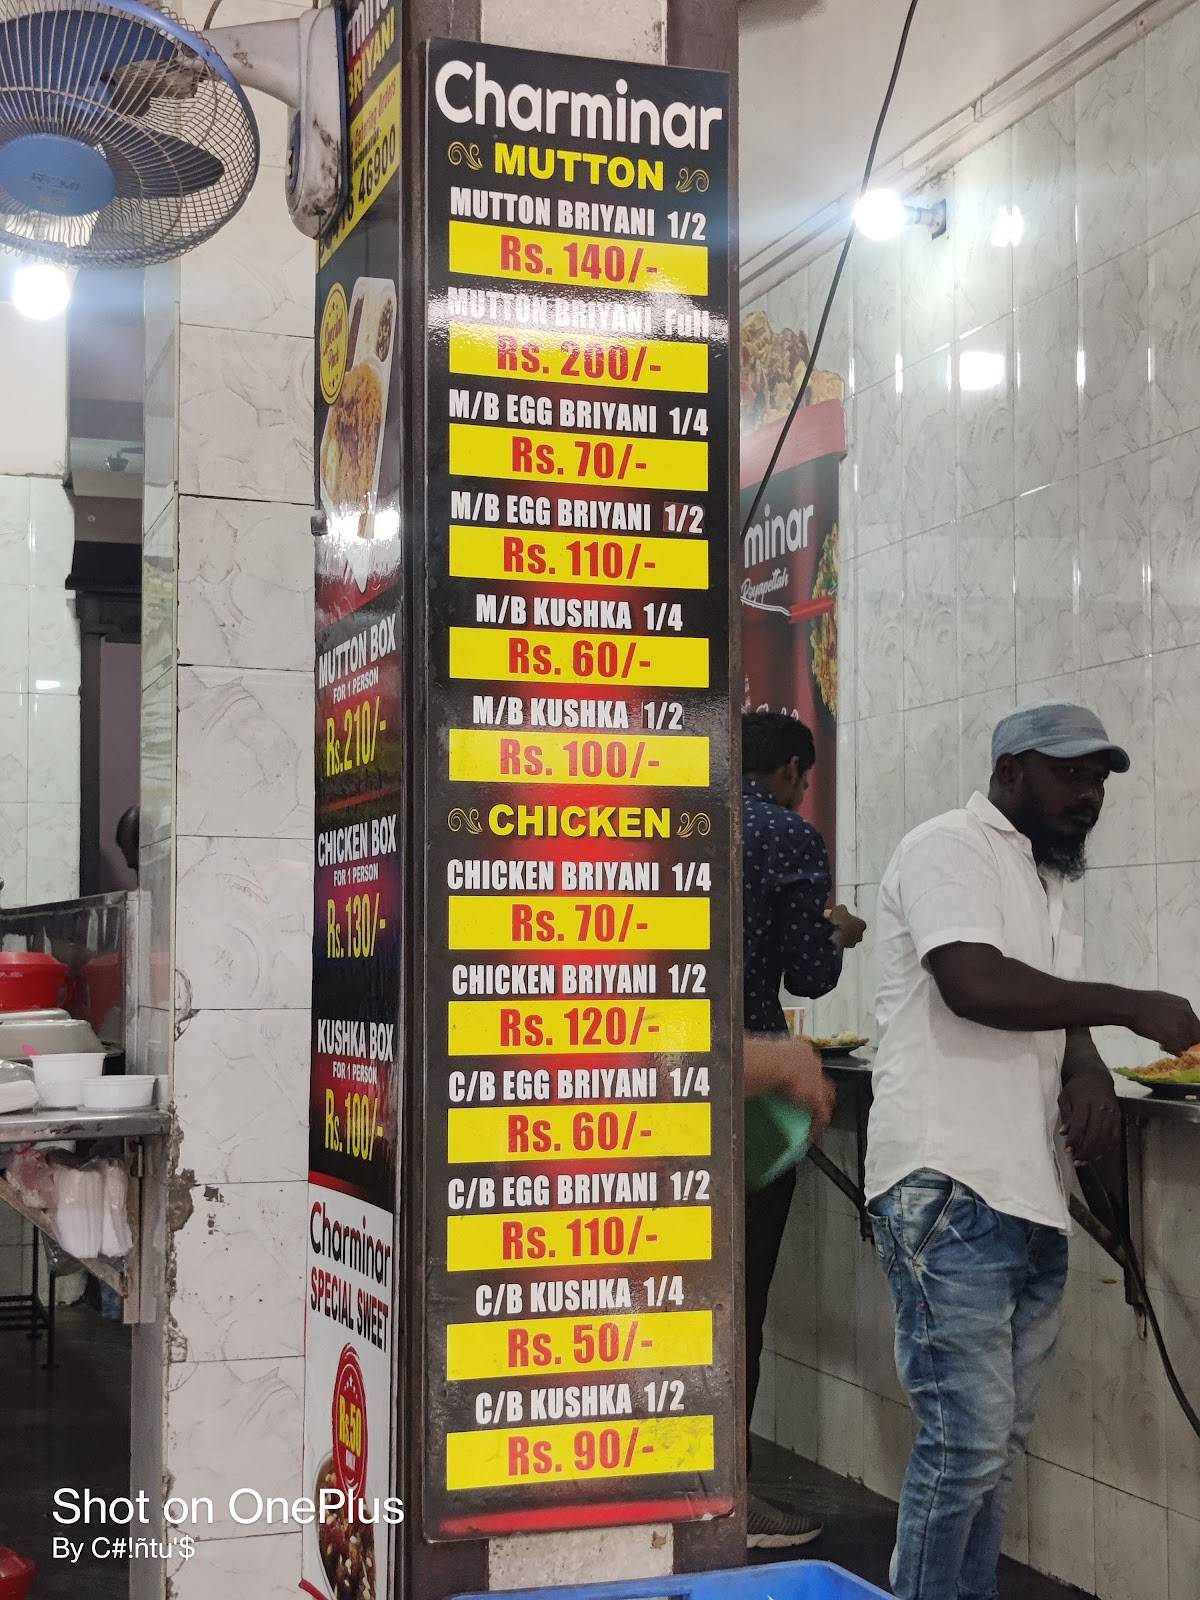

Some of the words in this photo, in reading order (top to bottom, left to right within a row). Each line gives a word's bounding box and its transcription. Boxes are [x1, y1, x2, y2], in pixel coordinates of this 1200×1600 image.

[434, 60, 723, 150] Charminar
[359, 123, 396, 205] 46900
[494, 142, 664, 191] MUTTON
[450, 186, 551, 226] MUTTON
[558, 200, 655, 237] BRIYANI
[667, 212, 706, 240] 1/2
[500, 235, 553, 275] Rs.
[563, 242, 657, 283] 140/-
[448, 286, 548, 326] MUTTON
[555, 297, 649, 334] BRIYANI
[665, 308, 709, 337] Full
[498, 333, 549, 374] Rs.
[561, 340, 662, 382] 200/-
[449, 389, 499, 421] M/B
[507, 394, 552, 426] EGG
[560, 399, 656, 433] BRIYANI
[669, 407, 708, 436] 1/4
[512, 436, 564, 475] Rs.
[574, 441, 647, 480] 70/-
[450, 491, 500, 521] M/B
[507, 496, 550, 526] EGG
[557, 499, 650, 531] BRIYANI
[664, 504, 704, 533] 1/2
[503, 536, 555, 575] Rs.
[566, 540, 656, 580] 110/-
[476, 594, 526, 625] M/B
[534, 597, 632, 629] KUSHKA
[643, 603, 683, 631] 1/4
[318, 630, 367, 689] MUTTON
[370, 613, 396, 663] BOX
[508, 637, 561, 675] Rs.
[572, 640, 651, 678] 60/-
[333, 685, 346, 705] FOR
[352, 667, 379, 696] PERSON
[473, 695, 523, 725] M/B
[530, 698, 628, 728] KUSHKA
[644, 701, 683, 730] 1/2
[500, 738, 552, 776] Rs.
[563, 740, 660, 779] 100/-
[317, 821, 368, 867] CHICKEN
[371, 814, 397, 857] BOX
[488, 803, 671, 838] CHICKEN
[333, 868, 346, 887] FOR
[352, 863, 379, 884] PERSON
[447, 859, 553, 891] CHICKEN
[561, 861, 660, 891] BRIYANI
[671, 862, 711, 891] 1/4
[511, 903, 565, 942] Rs.
[575, 903, 648, 943] 70/-
[452, 964, 555, 995] CHICKEN
[562, 964, 656, 994] BRIYANI
[668, 963, 706, 994] 1/2
[317, 1018, 366, 1058] KUSHKA
[369, 1022, 394, 1062] BOX
[500, 1008, 552, 1047] Rs.
[563, 1006, 660, 1046] 120/-
[332, 1060, 346, 1080] FOR
[352, 1063, 377, 1085] PERSON
[449, 1070, 495, 1102] C/B
[503, 1069, 550, 1101] EGG
[557, 1067, 657, 1100] BRIYANI
[670, 1067, 710, 1097] 1/4
[508, 1114, 561, 1153] Rs.
[572, 1110, 652, 1151] 60/-
[448, 1177, 495, 1209] C/B
[503, 1175, 550, 1207] EGG
[557, 1171, 657, 1204] BRIYANI
[670, 1170, 710, 1201] 1/2
[310, 1201, 390, 1287] Charminar
[502, 1220, 555, 1260] Rs.
[566, 1215, 657, 1257] 110/-
[310, 1266, 354, 1331] SPECIAL
[357, 1287, 389, 1353] SWEET
[475, 1284, 523, 1316] C/B
[530, 1277, 632, 1313] KUSHKA
[643, 1275, 684, 1307] 1/4
[508, 1328, 562, 1368] Rs.
[573, 1320, 653, 1364] 50/-
[475, 1390, 523, 1425] C/B
[530, 1383, 632, 1420] KUSHKA
[644, 1380, 685, 1413] 1/2
[508, 1435, 562, 1476] Rs.
[573, 1427, 654, 1471] 90/-
